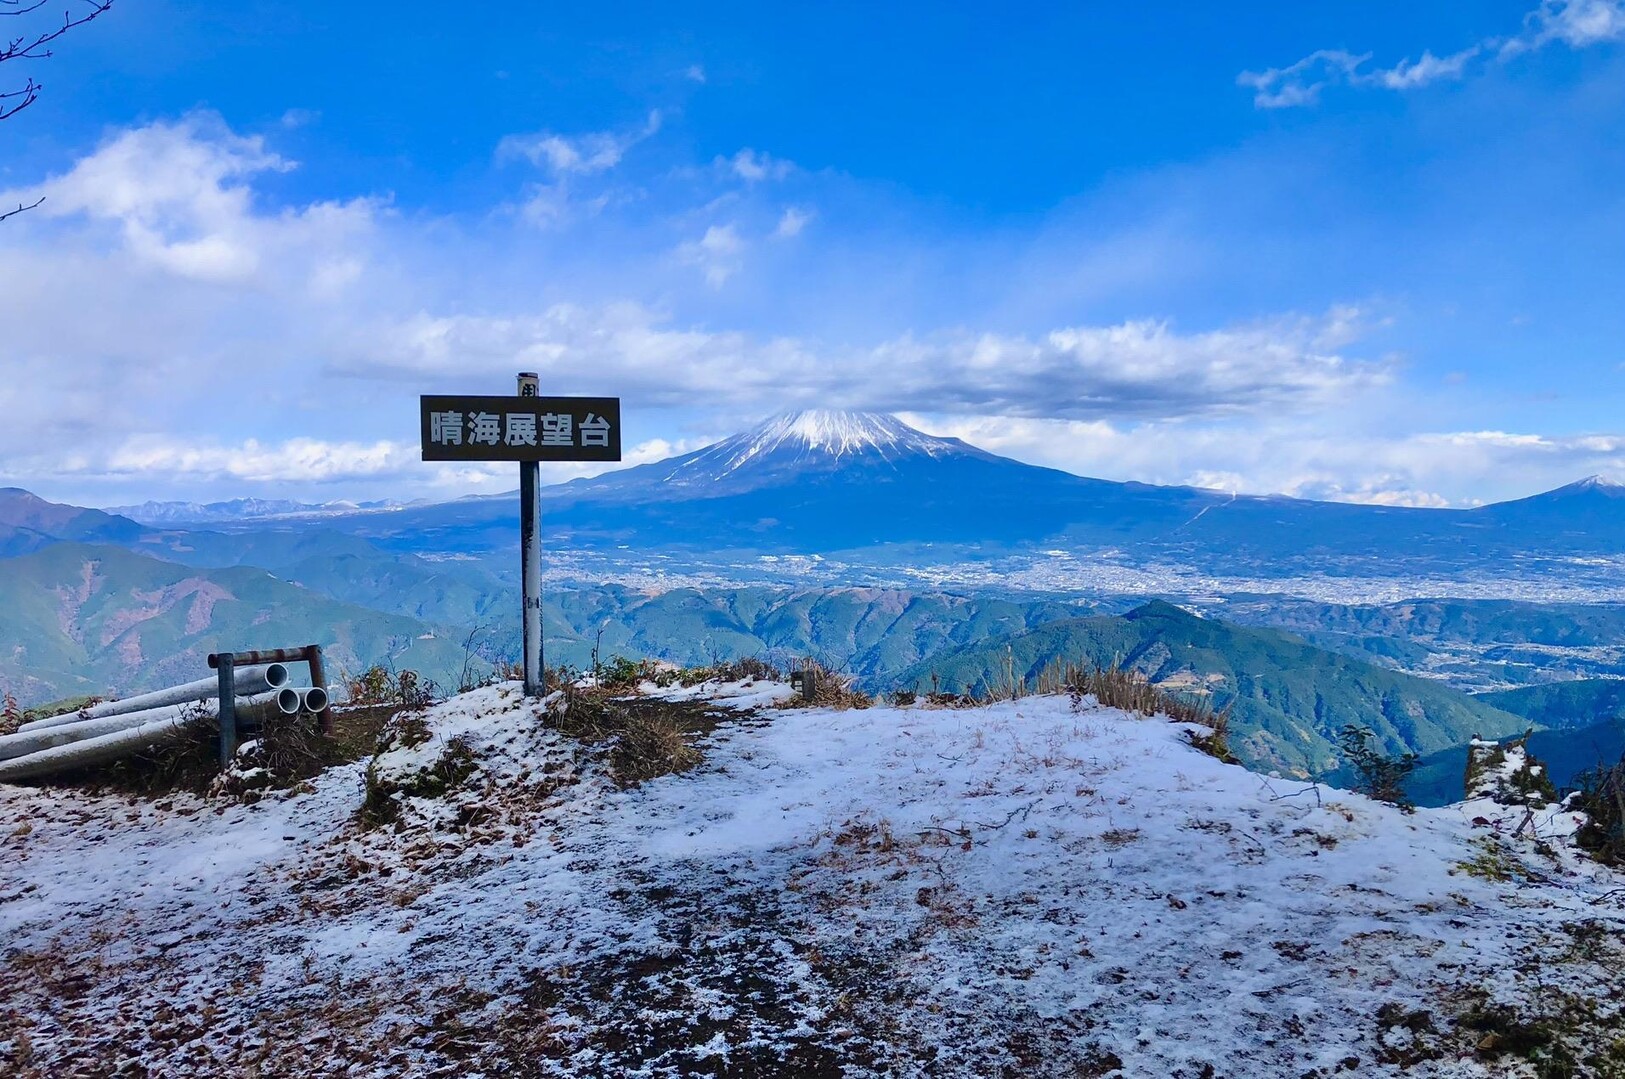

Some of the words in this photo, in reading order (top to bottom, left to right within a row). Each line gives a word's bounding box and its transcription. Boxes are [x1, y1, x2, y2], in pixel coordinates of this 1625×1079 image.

[430, 410, 611, 447] 晴海展望台
